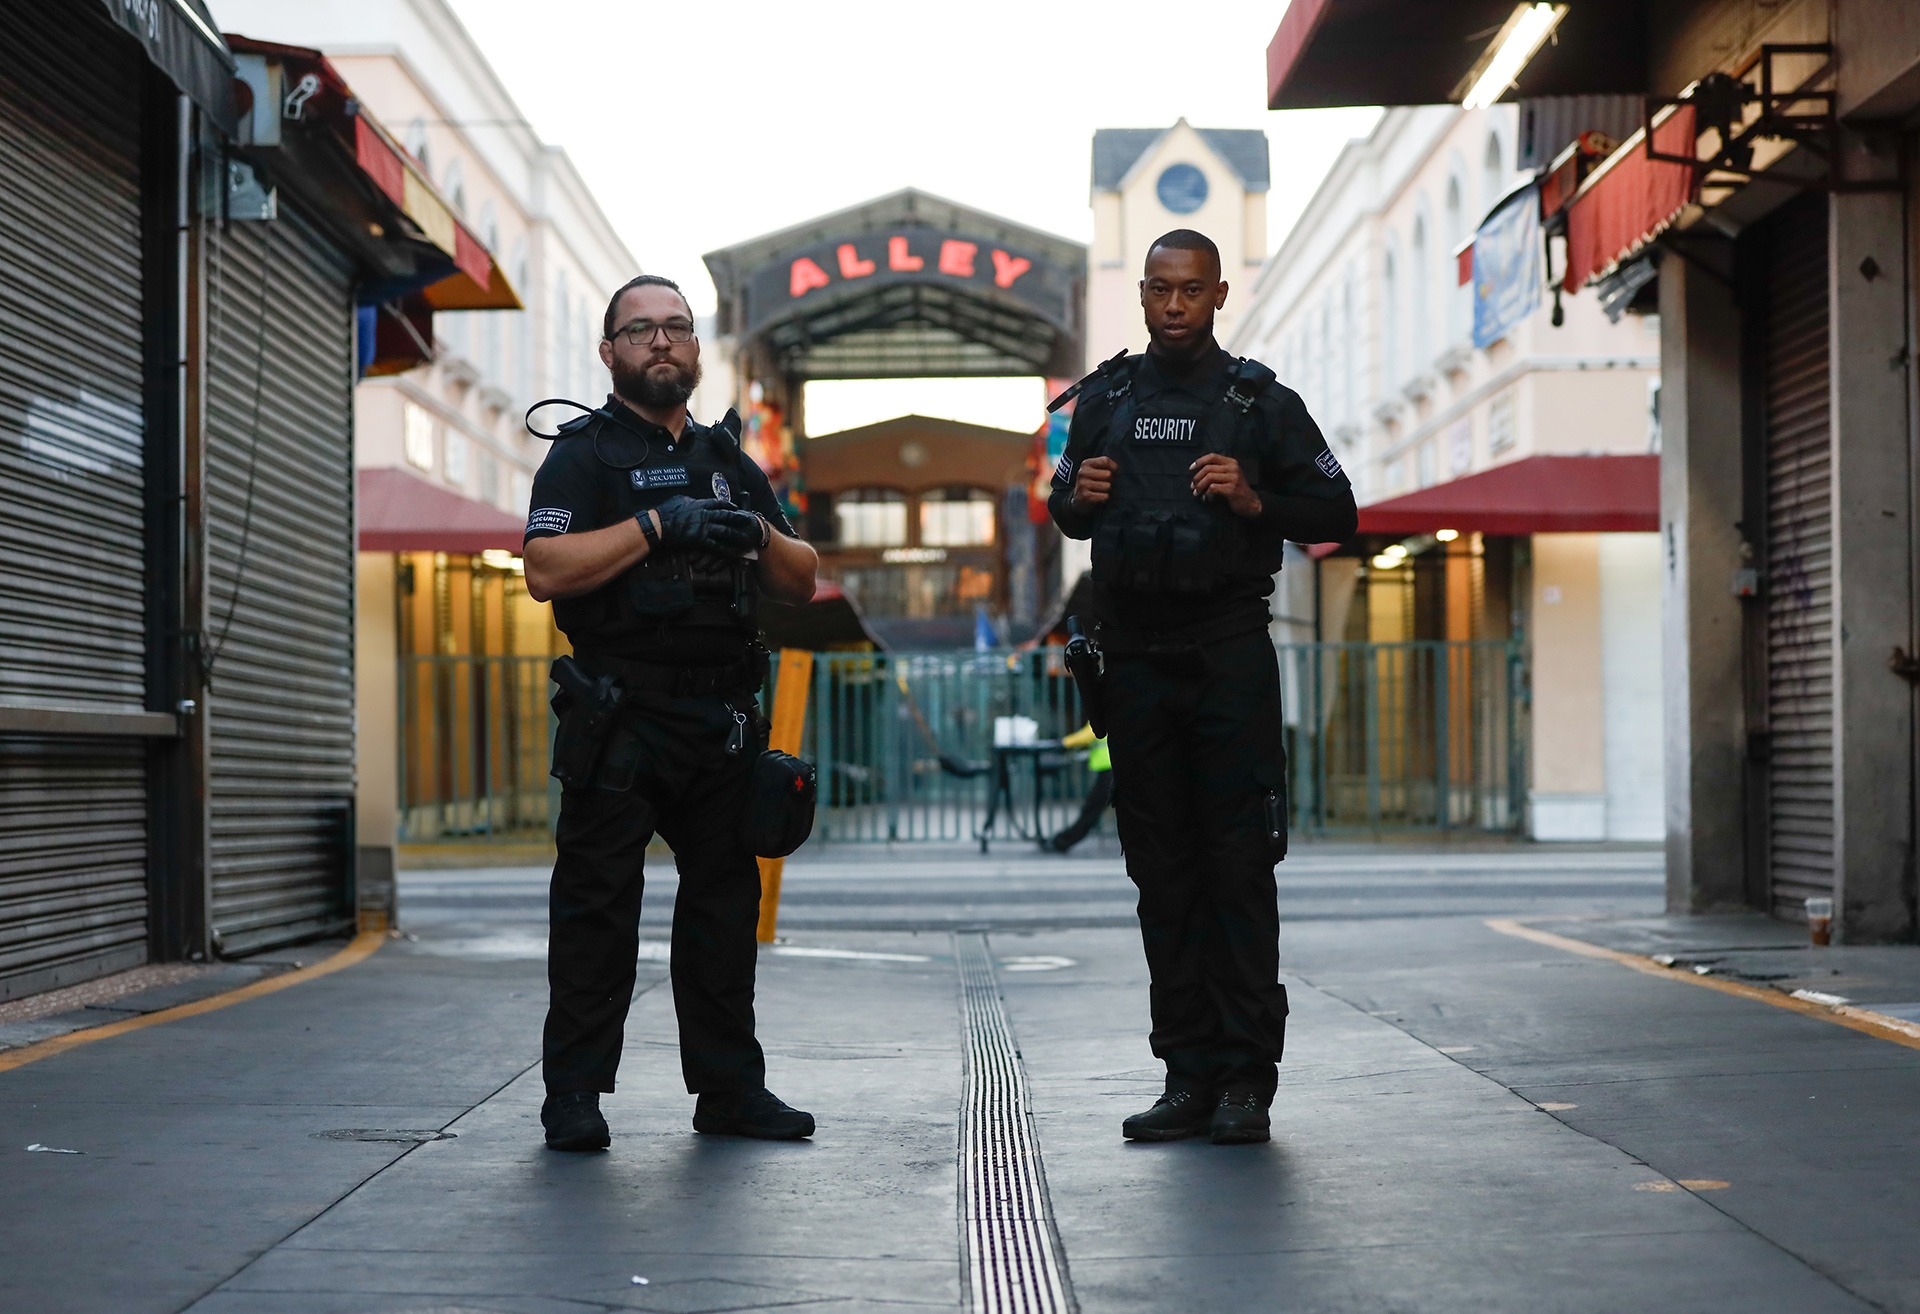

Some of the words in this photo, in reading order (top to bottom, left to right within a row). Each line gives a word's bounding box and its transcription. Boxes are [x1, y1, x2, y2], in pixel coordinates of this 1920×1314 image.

[790, 235, 1031, 298] ALLEY
[1134, 417, 1196, 441] SECURITY
[649, 474, 686, 482] SECURITY
